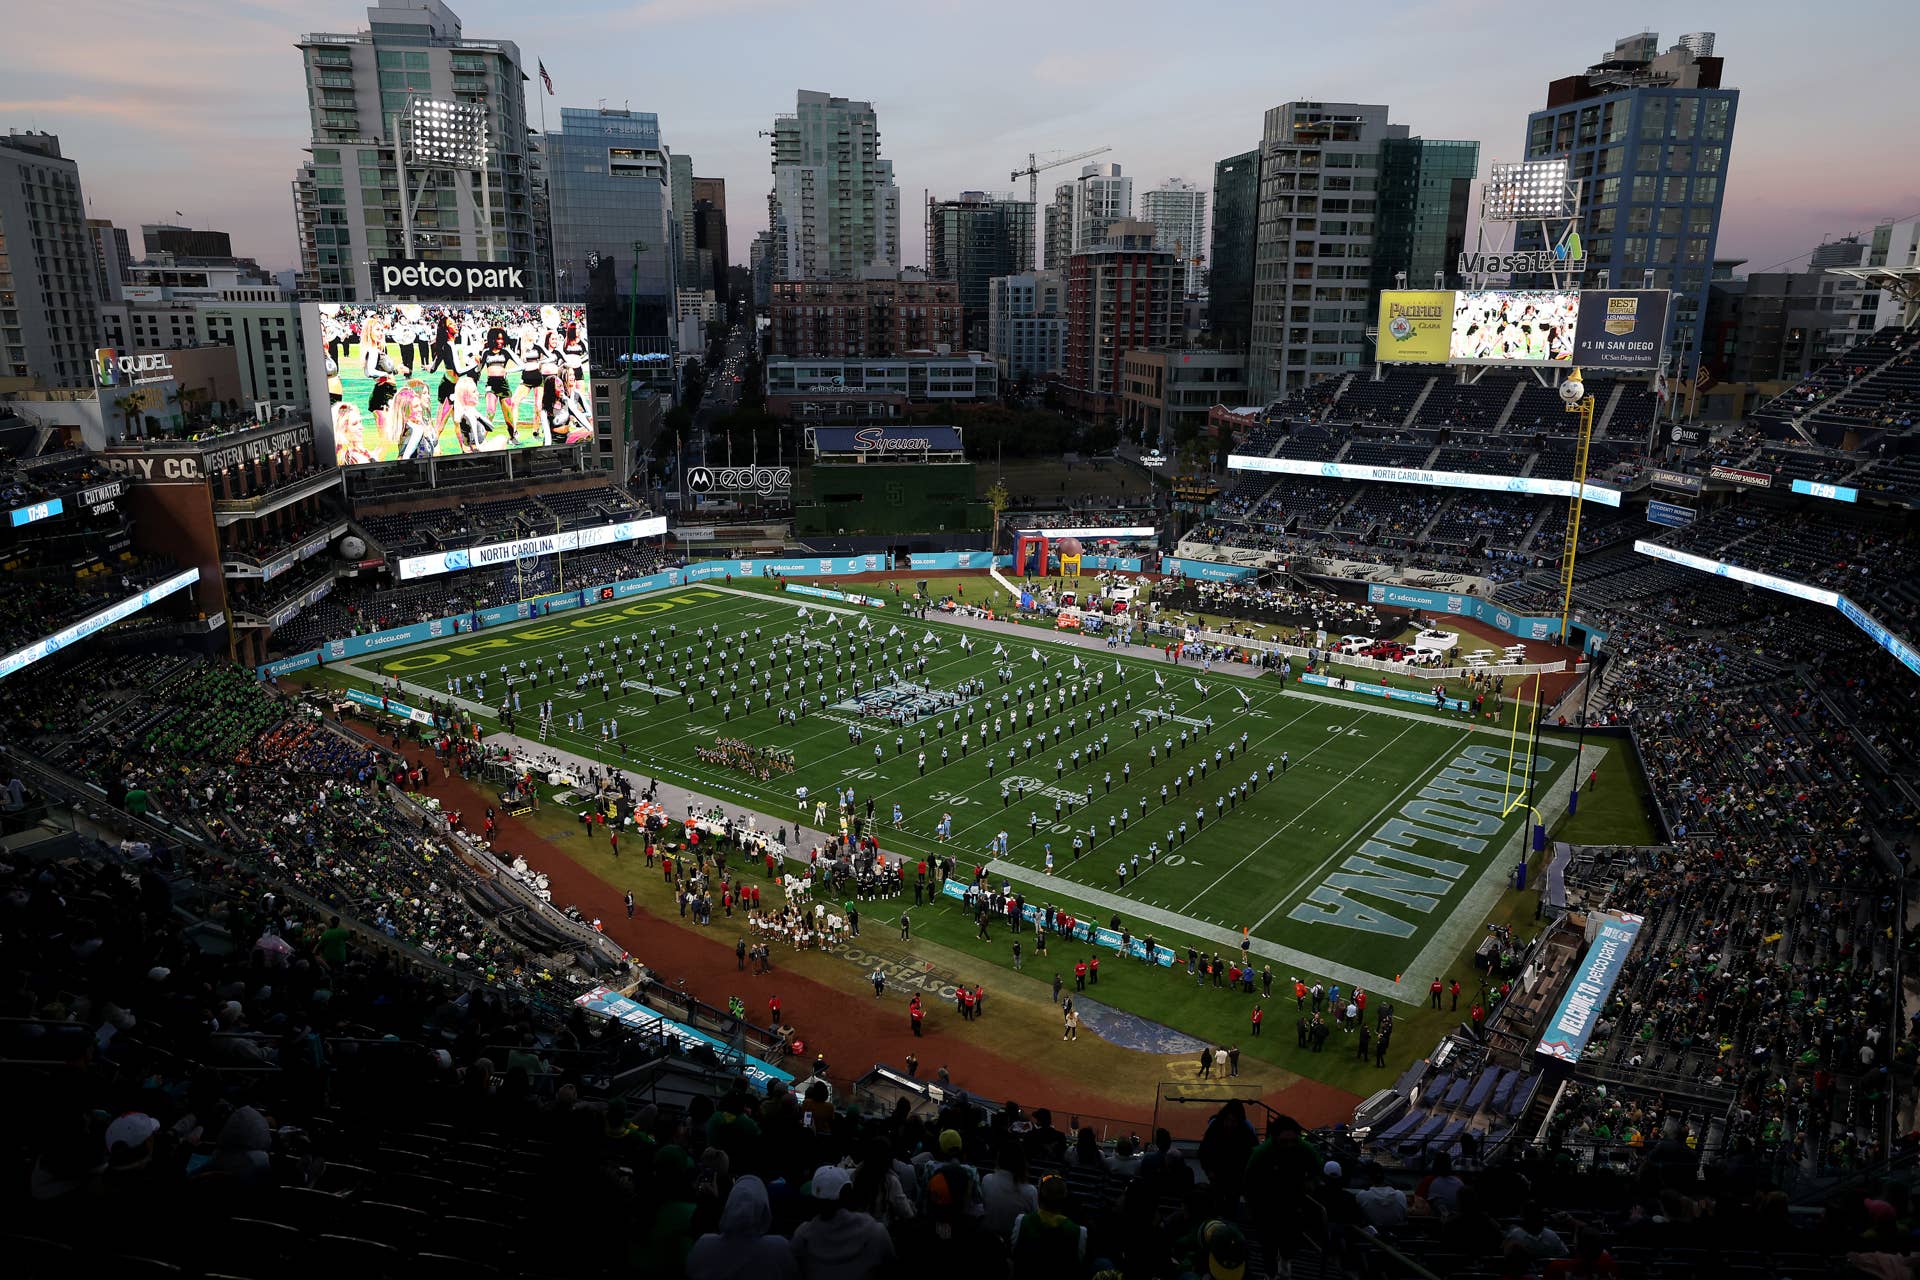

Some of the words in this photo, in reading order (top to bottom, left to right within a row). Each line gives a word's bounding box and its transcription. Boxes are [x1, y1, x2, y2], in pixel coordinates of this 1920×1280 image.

[1462, 252, 1543, 273] Viasat
[382, 261, 462, 293] petco
[466, 266, 524, 294] park
[1609, 299, 1636, 308] BEST
[1581, 341, 1592, 350] #1
[1595, 341, 1605, 350] IN
[1607, 342, 1626, 350] SAN
[1628, 342, 1654, 351] DIEGO
[118, 354, 173, 374] QUIDEL
[853, 428, 931, 455] Sycuan
[1681, 430, 1699, 440] MRC
[204, 446, 245, 473] WESTERN
[247, 437, 271, 458] METAL
[271, 430, 298, 454] SUPPLY
[163, 458, 205, 479] CO.
[1372, 469, 1396, 478] NORTH
[1397, 471, 1434, 483] CAROLINA
[1711, 467, 1742, 481] Tarantino
[1742, 475, 1769, 486] SAUSAGES
[720, 464, 792, 496] edge
[1810, 482, 1836, 498] 17:09
[84, 484, 121, 504] CUTWATER
[92, 501, 115, 516] SPIRITS
[480, 548, 509, 562] NORTH
[511, 540, 553, 557] CAROLINA
[1417, 574, 1465, 587] Templeton
[603, 588, 613, 598] 25
[1397, 594, 1432, 605] sdccu.com
[374, 632, 411, 644] sdccu.com
[384, 592, 723, 671] OREGON
[278, 656, 310, 671] sdccu.com
[929, 791, 969, 806] 30
[1287, 745, 1556, 939] CAROLINA
[1603, 940, 1620, 962] park
[829, 943, 966, 1001] POSTSEASO
[1587, 955, 1609, 986] petco
[1577, 982, 1601, 998] TO
[1557, 991, 1596, 1037] WELCOME
